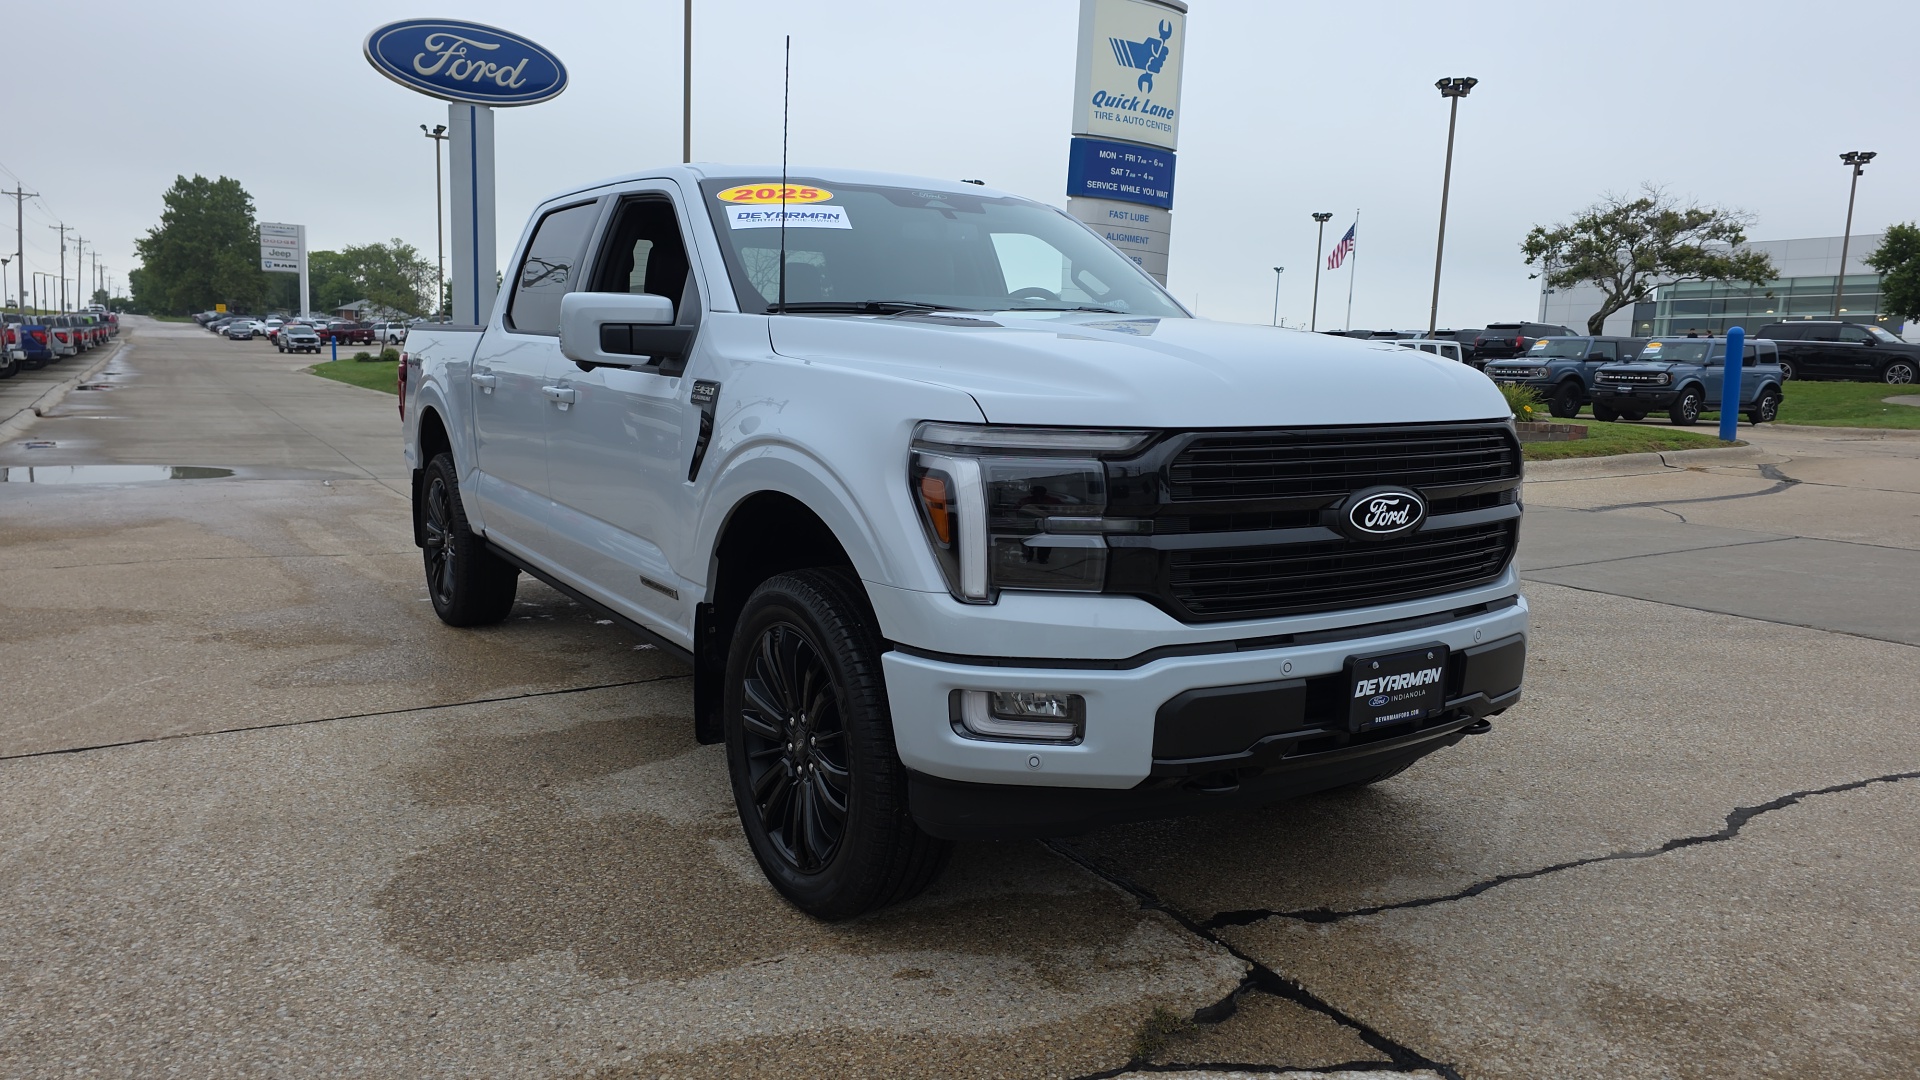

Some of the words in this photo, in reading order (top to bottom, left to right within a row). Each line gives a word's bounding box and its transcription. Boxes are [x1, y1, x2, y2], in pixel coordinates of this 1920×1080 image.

[413, 32, 530, 89] Ford
[1092, 90, 1141, 111] Quick
[1141, 99, 1174, 119] Lane
[1094, 111, 1114, 121] TIRE
[1115, 113, 1121, 122] &
[1122, 115, 1145, 126] AUTO
[1146, 120, 1172, 133] CENTER
[1099, 150, 1117, 160] MON
[1124, 153, 1136, 162] FRI
[1110, 167, 1124, 176] SAT
[733, 188, 818, 200] 2025
[1086, 180, 1118, 191] SERVICE
[1120, 184, 1140, 194] WHILE
[1142, 187, 1155, 196] YOU
[1156, 190, 1169, 199] WAIT
[737, 211, 840, 220] DEYARMAN
[1109, 210, 1128, 220] FAST
[1130, 213, 1150, 223] LUBE
[1106, 232, 1149, 244] ALIGNMENT
[269, 249, 291, 258] Jeep
[1365, 499, 1410, 527] Ford
[1355, 667, 1442, 698] DEYARMAN
[1391, 690, 1426, 701] INDIANOLA
